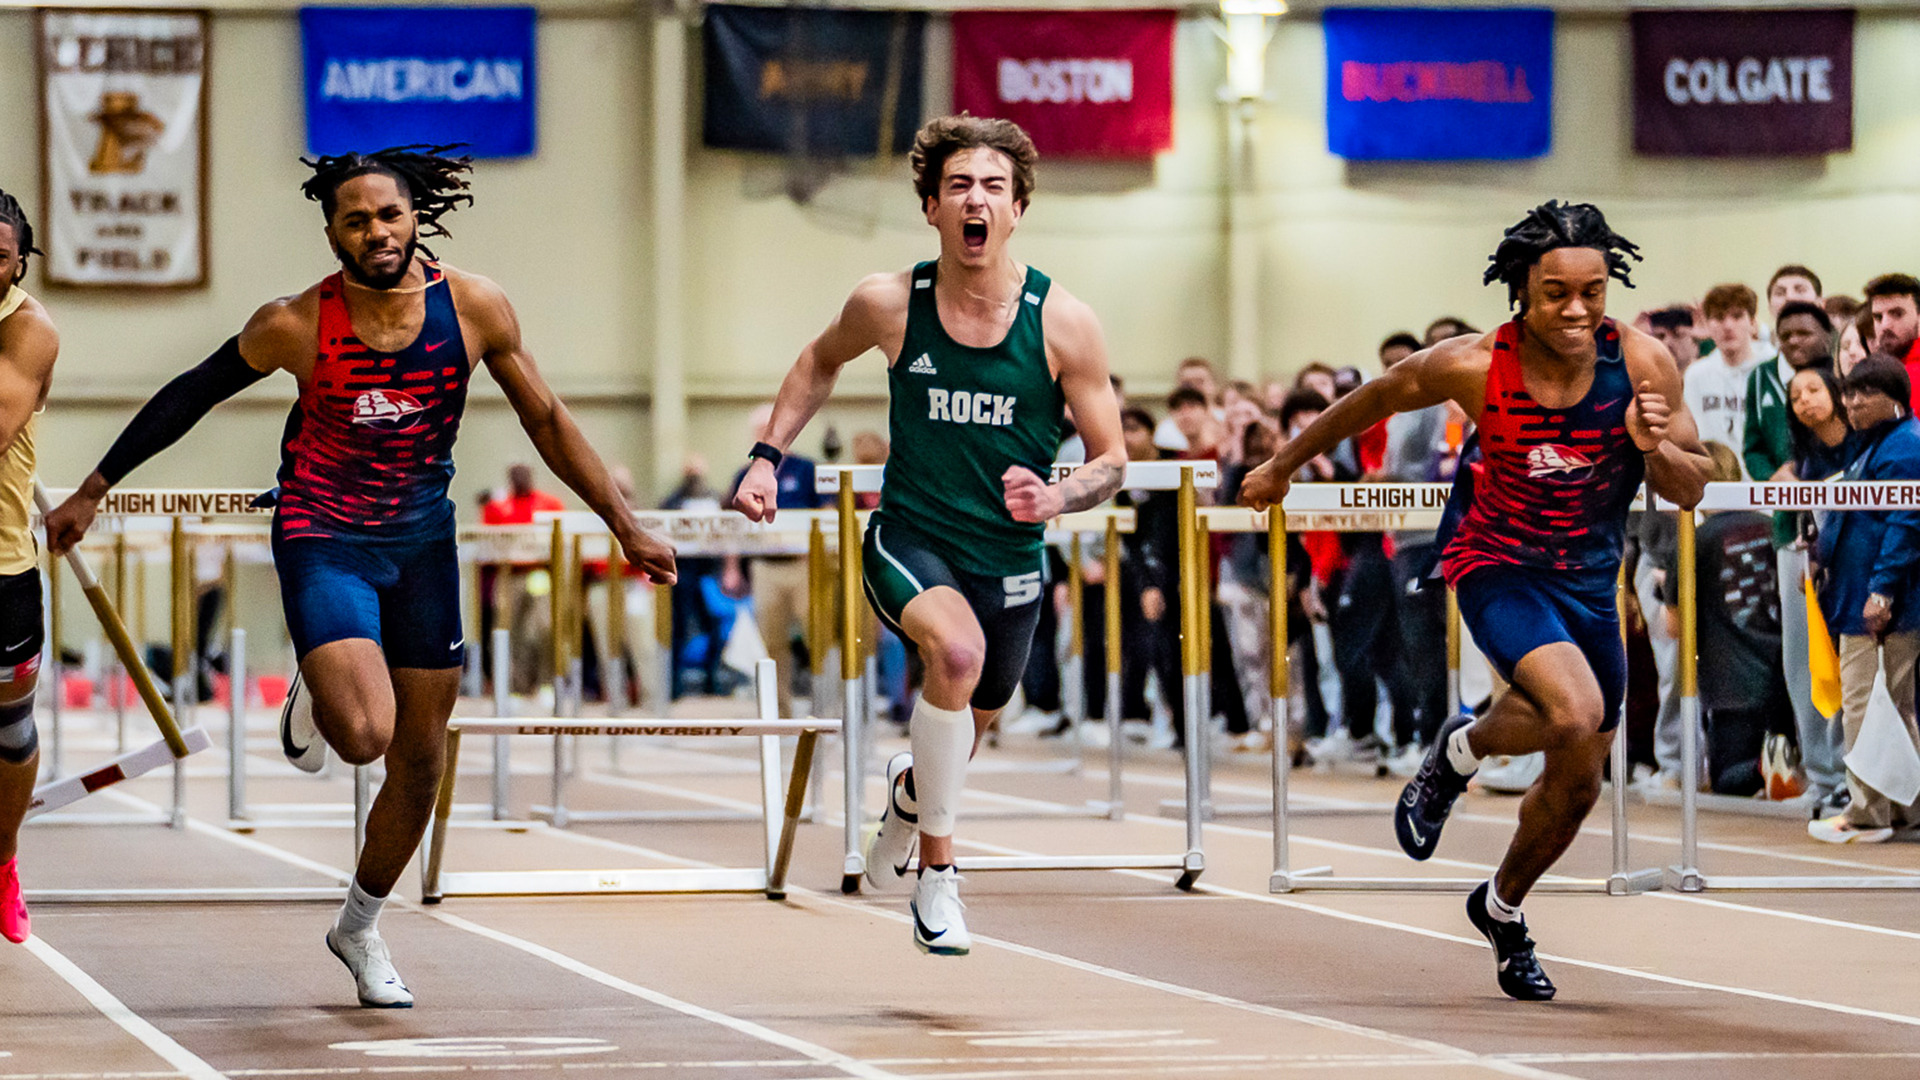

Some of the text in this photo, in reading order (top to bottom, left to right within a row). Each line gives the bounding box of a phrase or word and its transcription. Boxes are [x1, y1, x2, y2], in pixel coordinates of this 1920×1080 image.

[322, 58, 523, 101] AMERICAN
[998, 58, 1133, 103] BOSTON
[1664, 57, 1833, 104] COLGATE
[928, 388, 1016, 426] ROCK
[97, 493, 273, 514] HIGH UNIVERS
[1340, 488, 1415, 508] LEHIGH
[1750, 486, 1827, 506] LEHIGH
[518, 725, 744, 736] LEHIGH UNIVERSITY
